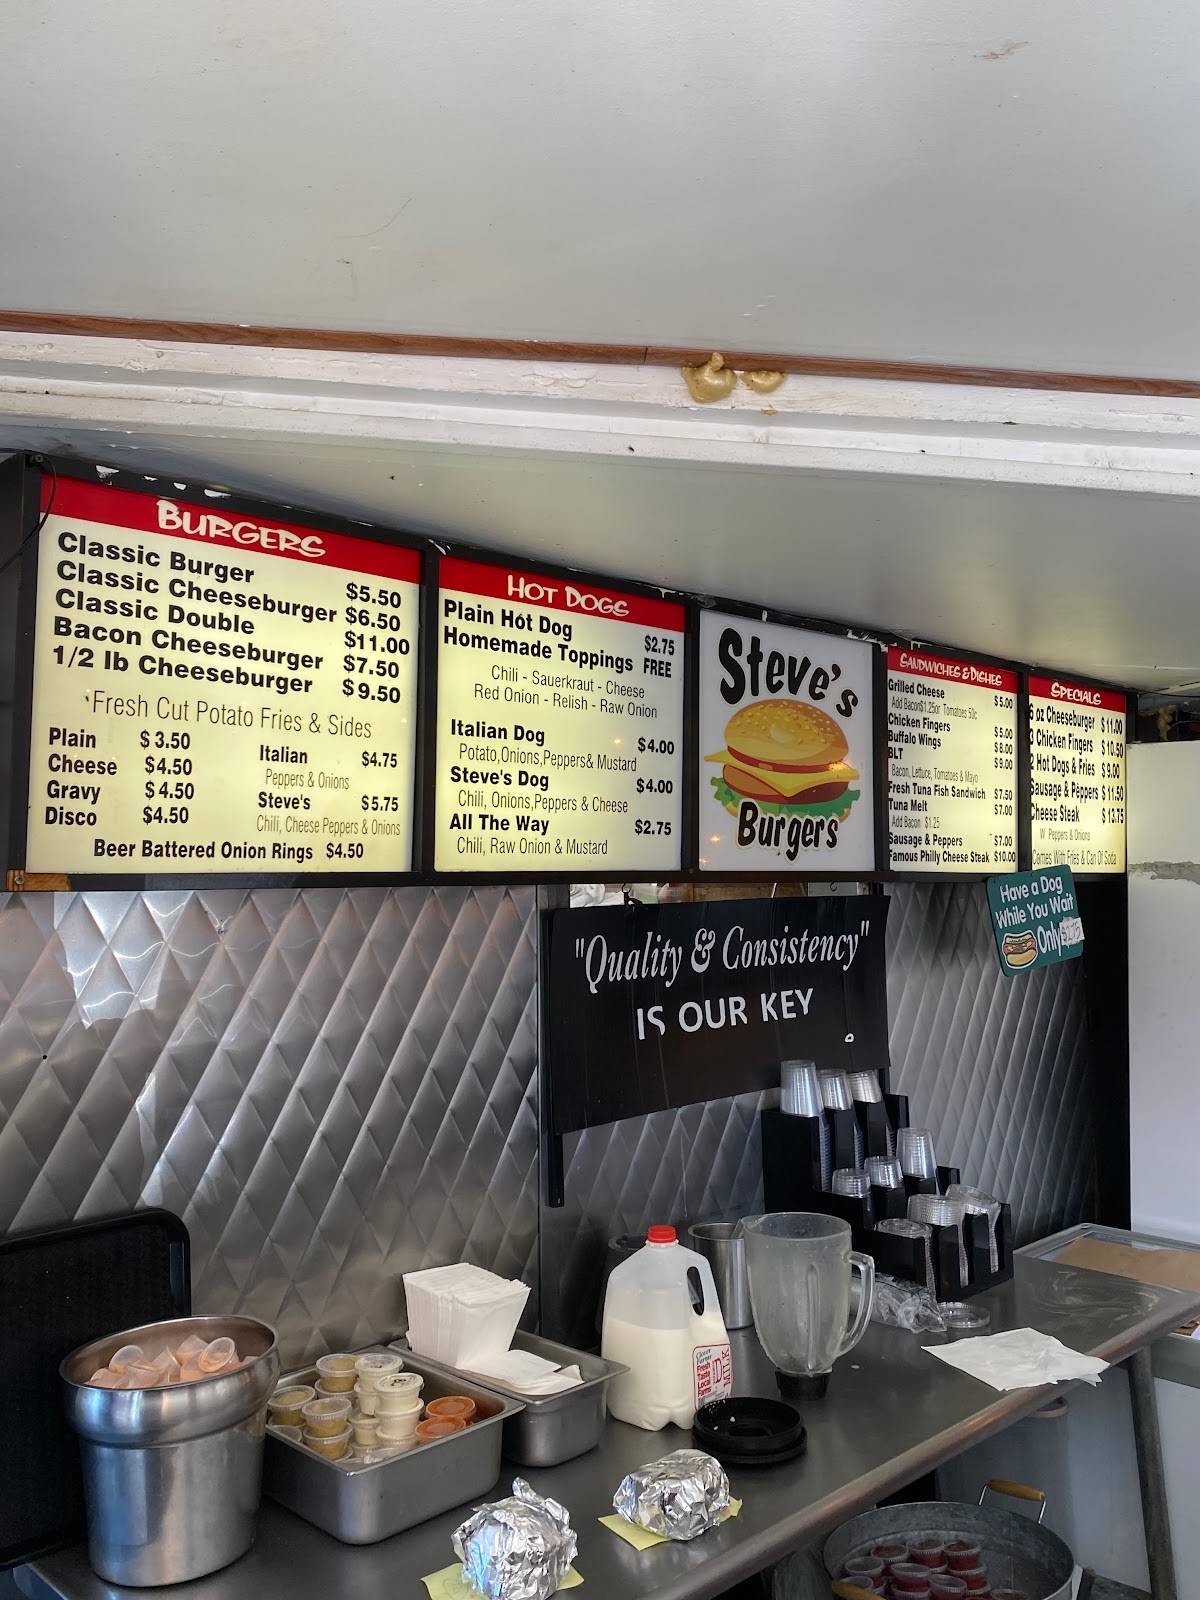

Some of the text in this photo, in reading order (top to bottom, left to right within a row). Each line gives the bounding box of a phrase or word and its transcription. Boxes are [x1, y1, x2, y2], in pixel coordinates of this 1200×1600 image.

[156, 500, 326, 558] BURGERS
[58, 531, 401, 608] Classic Burger $5.50
[57, 560, 400, 631] Classic Cheeseburger $6.50
[507, 575, 630, 616] HOT DOGS
[55, 588, 410, 655] Classic Double $11.00
[444, 599, 675, 656] Plain Hot Dog $2.75
[54, 616, 399, 678] Bacon Cheeseburger $7.50
[444, 626, 672, 678] Homemade Toppings FREE
[53, 645, 94, 668] 1/2
[104, 651, 129, 671] lb
[138, 655, 313, 695] Cheeseburger
[718, 627, 858, 718] Steve's
[900, 653, 961, 678] SANDWICHES
[491, 665, 645, 698] Chili Sauerkraut Cheese
[889, 679, 914, 695] Grilled
[917, 683, 945, 699] Cheese
[1051, 682, 1101, 705] SPECIALS
[474, 684, 657, 718] Red Onion Relish Raw Onion
[93, 690, 372, 738] Fresh Cut Potato Fries & Sides
[889, 713, 920, 728] Chicken
[923, 717, 951, 733] Fingers
[1047, 705, 1095, 732] Cheeseburger
[49, 727, 96, 748] Plain
[450, 718, 507, 740] Italian
[513, 724, 545, 746] Dog
[888, 730, 916, 744] Buffalo
[919, 734, 941, 749] Wings
[1037, 729, 1093, 755] Chicken Fingers
[48, 753, 117, 775] Cheese
[260, 745, 397, 768] Italian $4.75
[597, 755, 637, 772] Mustard
[888, 746, 903, 759] BLT
[1037, 753, 1095, 777] Hot Dogs & Fries
[266, 768, 349, 789] Peppers & Onions
[450, 766, 673, 794] Steve's Dog $4.00
[888, 781, 910, 795] Fresh
[913, 783, 931, 796] Tuna
[934, 785, 949, 797] Fish
[951, 786, 985, 800] Sandwich
[47, 780, 100, 805] Gravy
[258, 791, 311, 810] Steve's
[458, 790, 488, 809] Chili,
[581, 796, 589, 810] &
[592, 796, 628, 813] Cheese
[889, 798, 908, 811] Tuna
[910, 799, 927, 811] Melt
[1064, 781, 1069, 798] &
[1072, 782, 1098, 803] Peppers
[45, 805, 188, 825] Disco $4.50
[449, 813, 672, 836] All The Way $2.75
[1031, 803, 1079, 822] Cheese Steak
[257, 815, 400, 837] Chili, Cheese Peppers & Onions
[738, 800, 838, 861] Burgers
[94, 839, 363, 863] Beer Battered Onion Rings $4.50
[457, 836, 608, 856] Chili, Raw Onion & Mustard
[889, 832, 922, 847] Sausage
[925, 834, 930, 845] &
[933, 834, 963, 849] Peppers
[921, 850, 940, 865] Philly
[943, 851, 968, 862] Cheese
[970, 852, 989, 863] Steak
[1000, 876, 1062, 903] Have a Dog
[995, 893, 1073, 929] While You Wait
[1037, 921, 1061, 956] Only
[575, 920, 870, 994] "Quality & Consistency"
[637, 988, 814, 1040] IS OUR KEY
